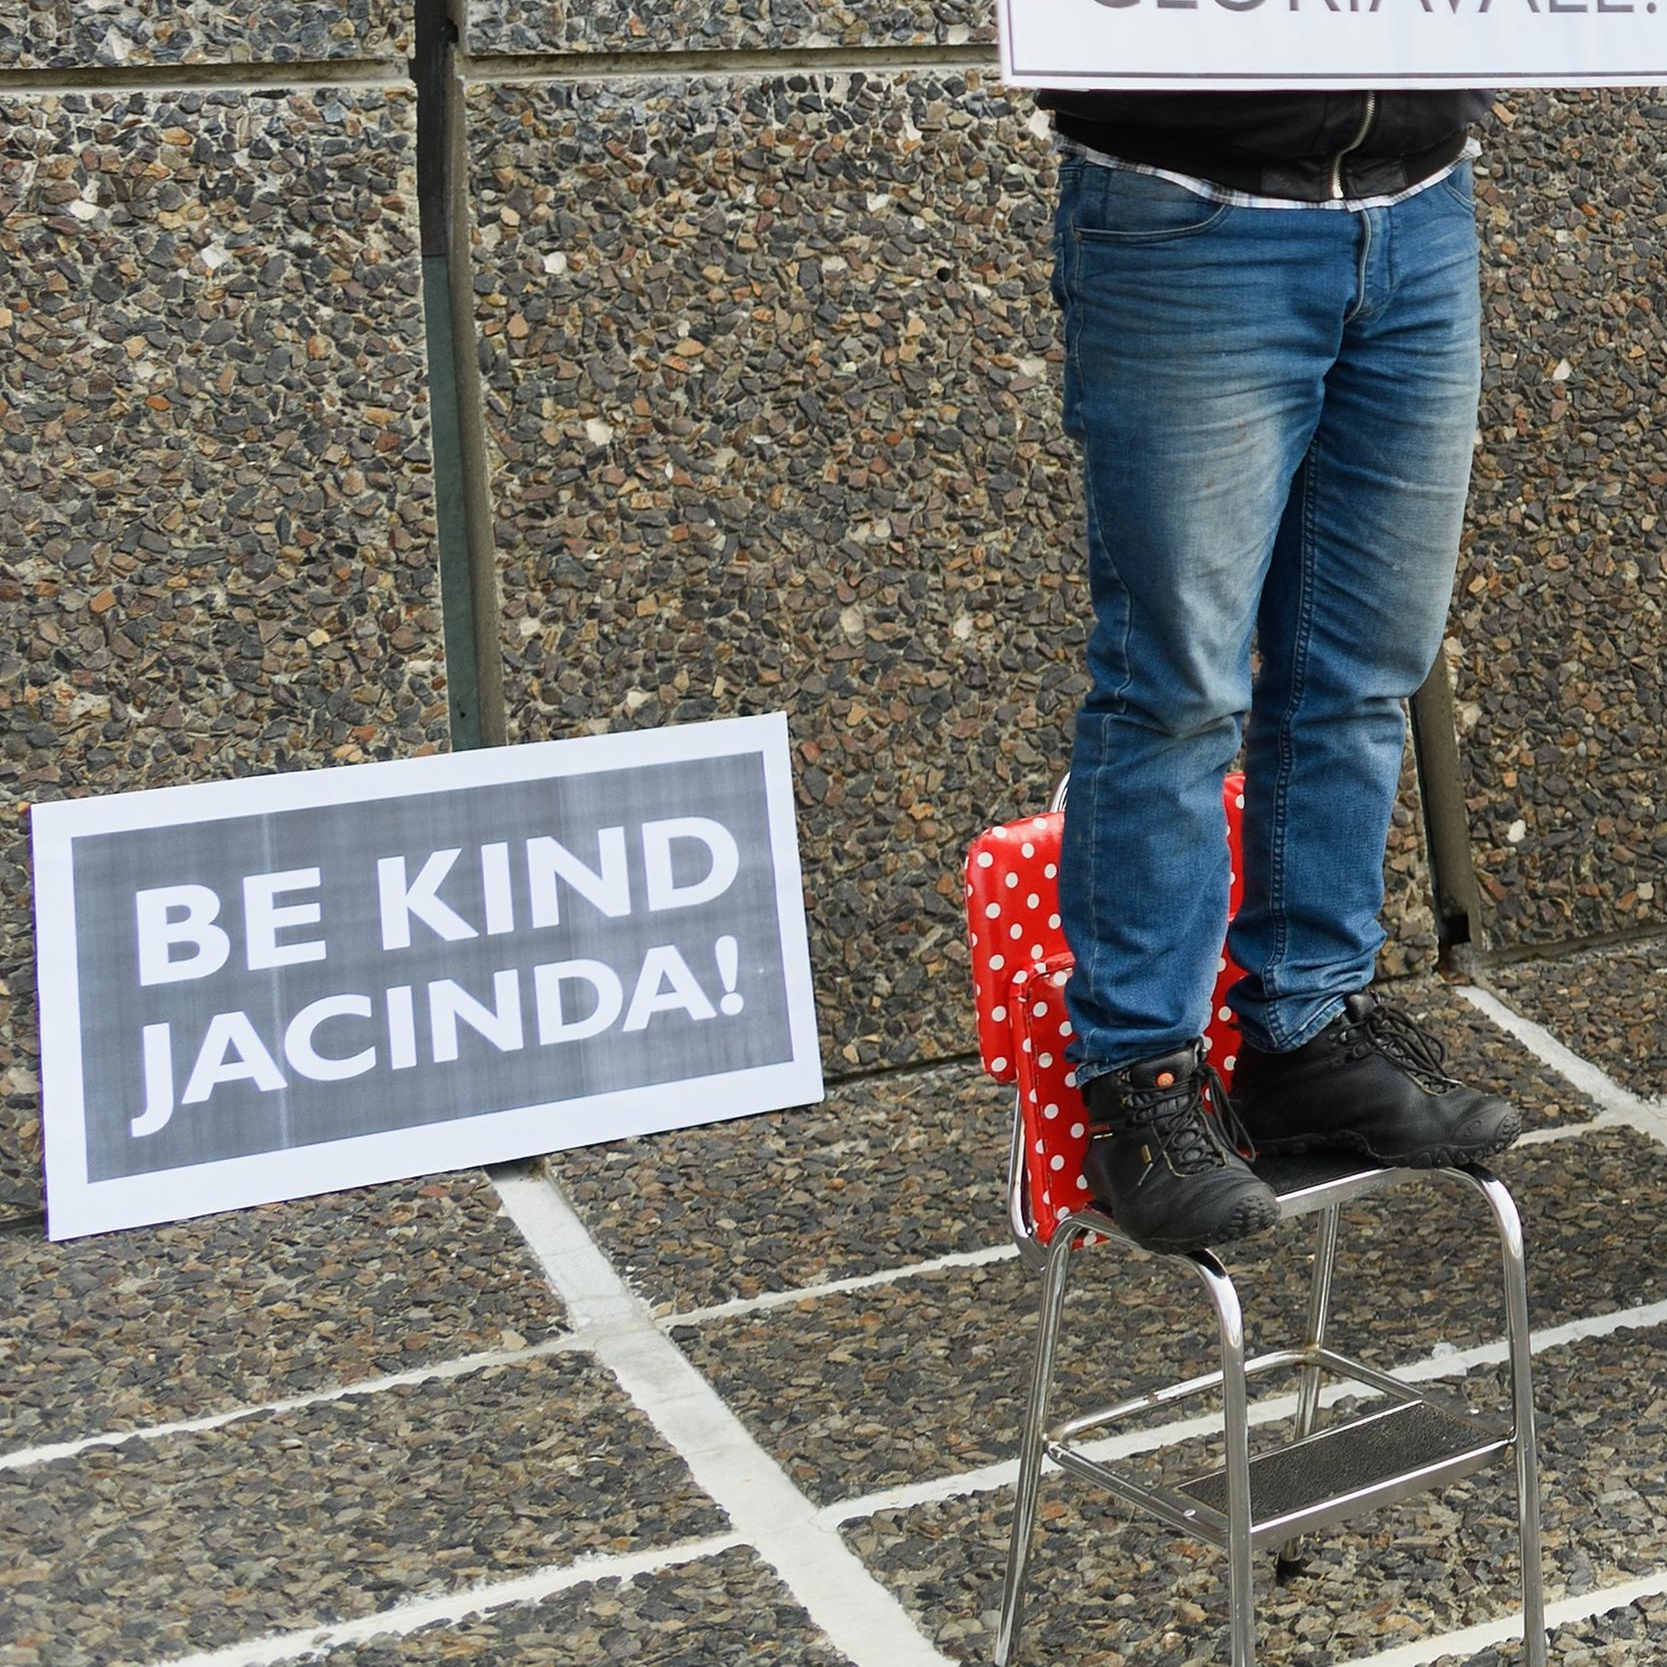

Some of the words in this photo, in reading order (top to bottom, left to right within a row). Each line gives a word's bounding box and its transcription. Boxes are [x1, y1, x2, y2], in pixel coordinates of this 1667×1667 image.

[135, 866, 327, 987] BE
[376, 816, 740, 951] KIND
[130, 934, 744, 1138] JACINDA!
